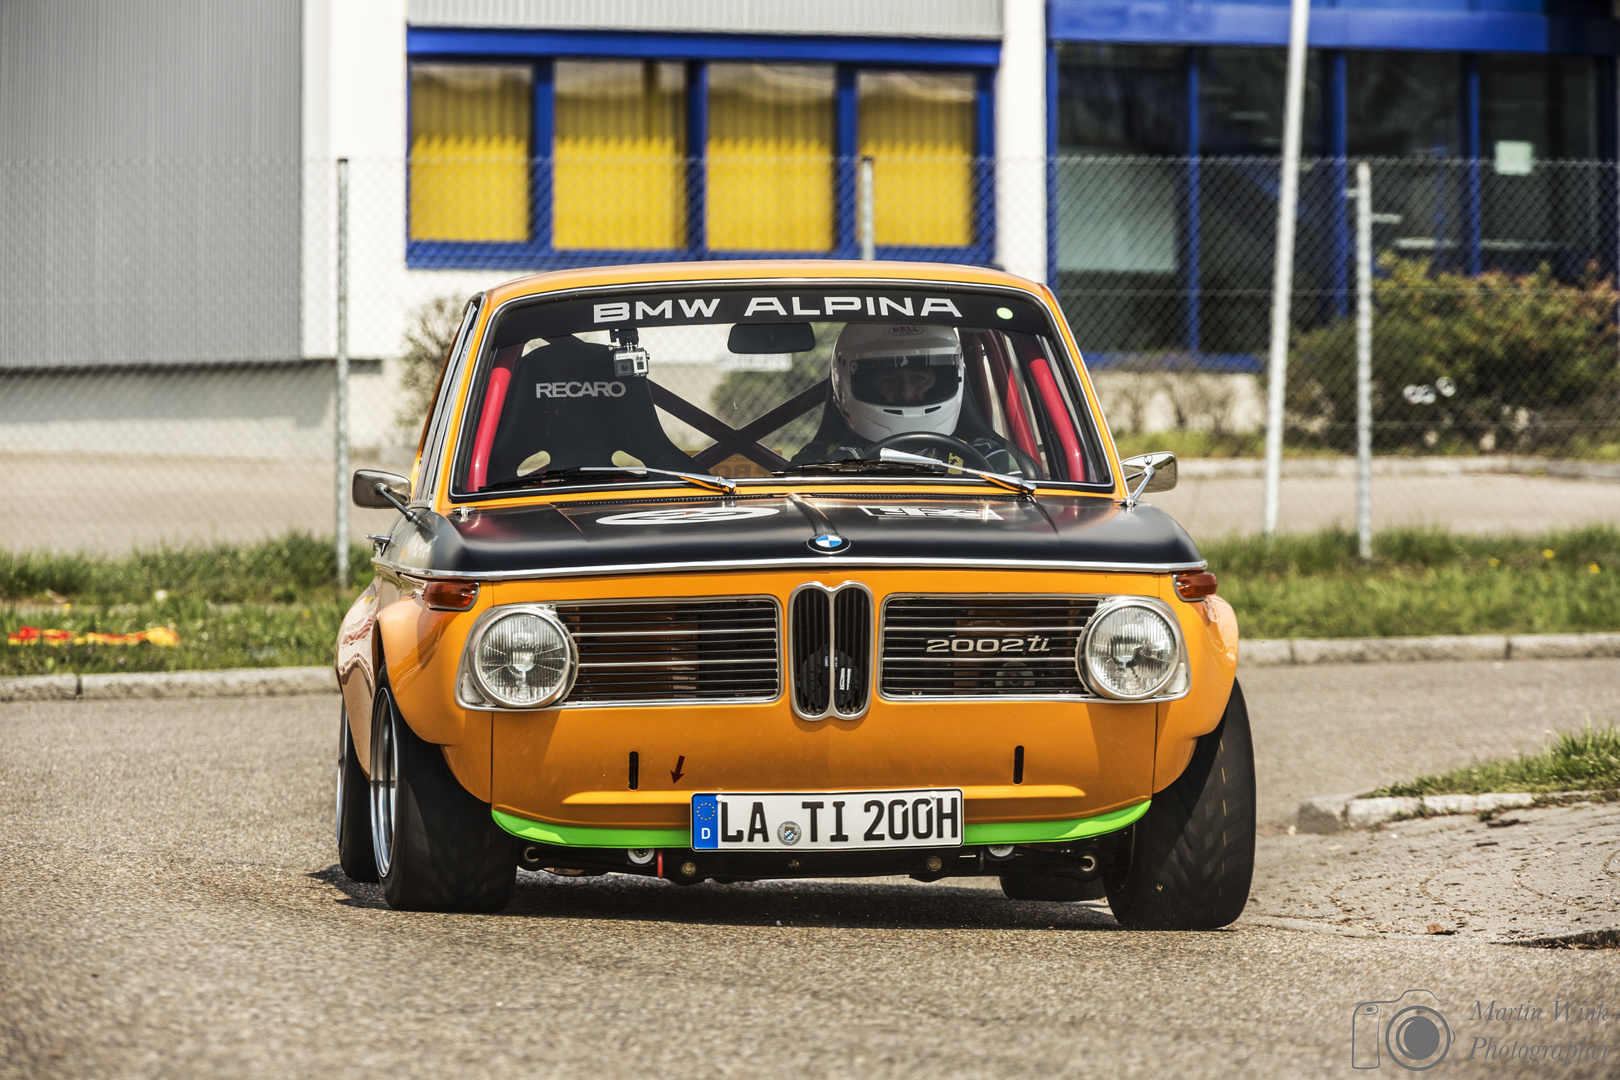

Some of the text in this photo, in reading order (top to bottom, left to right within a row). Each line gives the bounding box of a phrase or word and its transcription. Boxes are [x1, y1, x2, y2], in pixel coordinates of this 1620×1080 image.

[593, 296, 963, 324] BMW ALPINA
[892, 325, 919, 333] BELL
[535, 381, 627, 399] RECARO
[926, 635, 1051, 653] 2002ti
[721, 801, 770, 843] LA
[802, 800, 849, 843] TI
[863, 797, 958, 842] 200H
[701, 828, 711, 840] D
